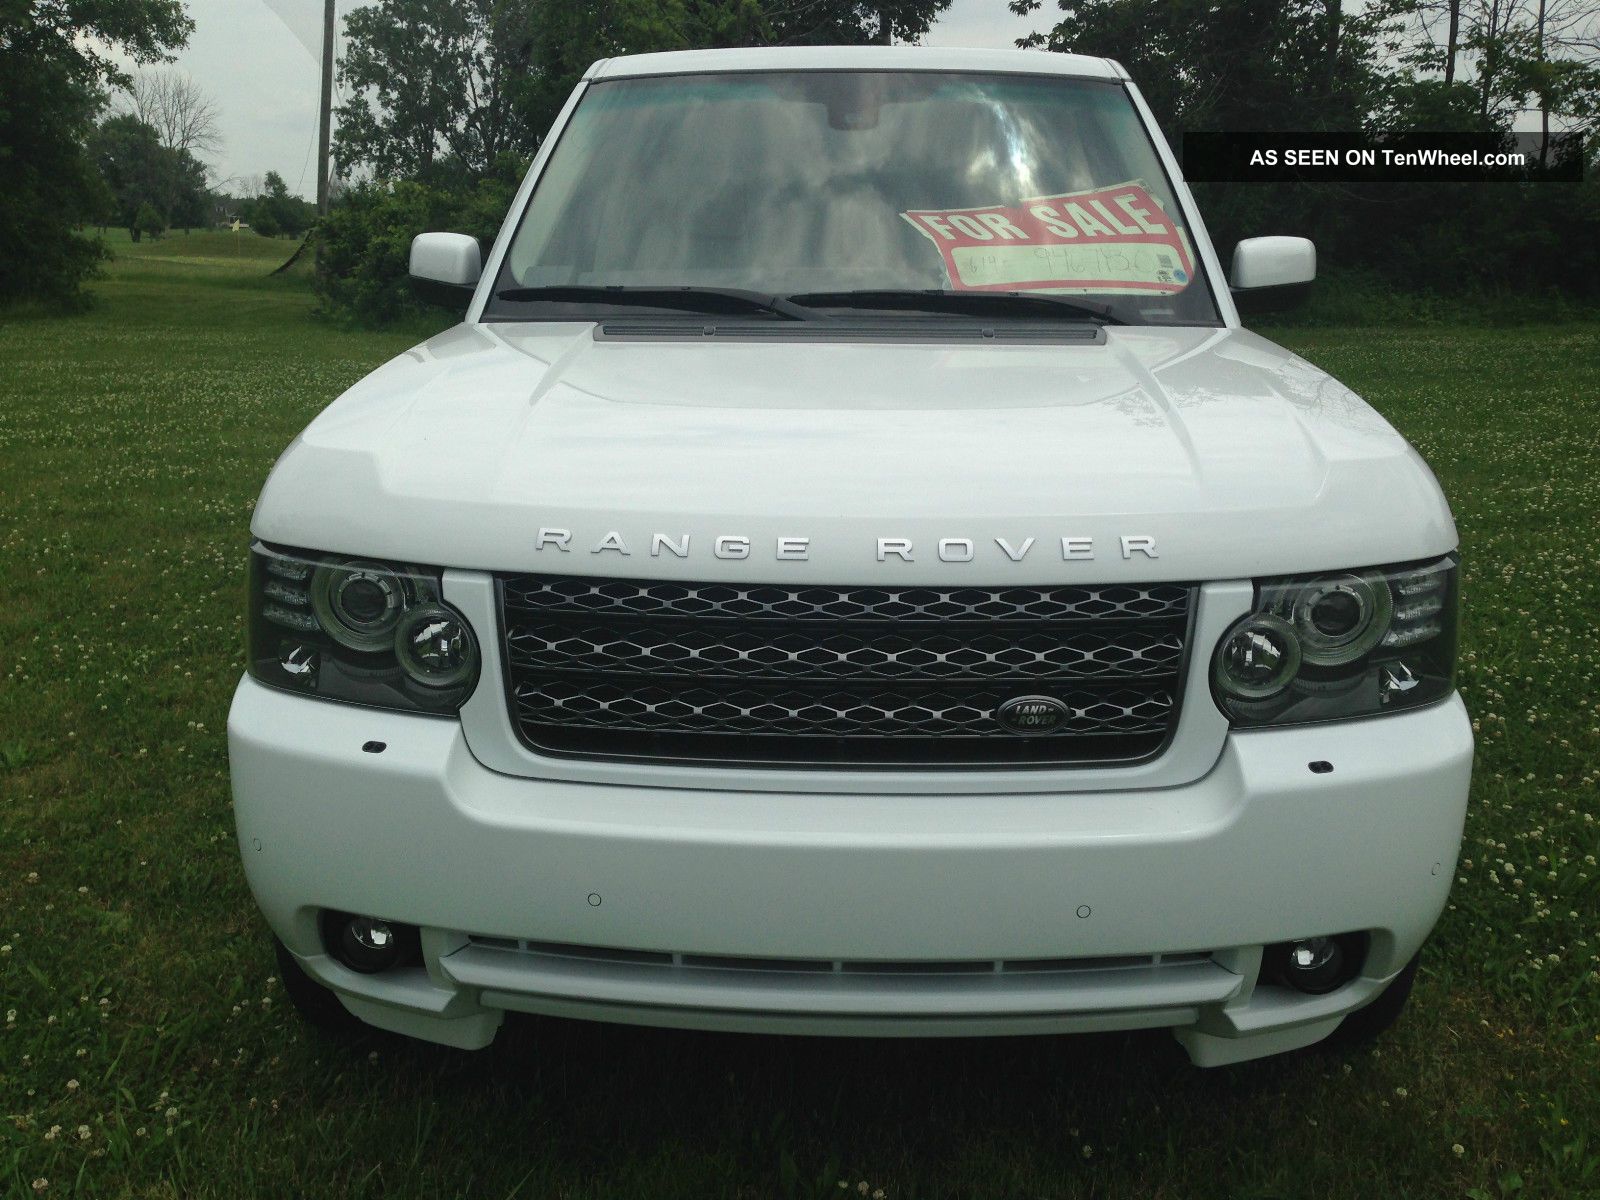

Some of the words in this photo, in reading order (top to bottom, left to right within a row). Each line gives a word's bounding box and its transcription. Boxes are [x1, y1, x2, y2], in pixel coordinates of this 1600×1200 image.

[919, 211, 1030, 241] FOR
[1029, 193, 1169, 239] SALE
[535, 527, 810, 561] RANGE
[876, 535, 1160, 563] ROVER
[1016, 705, 1047, 715] LAND
[1018, 715, 1056, 725] ROVER
